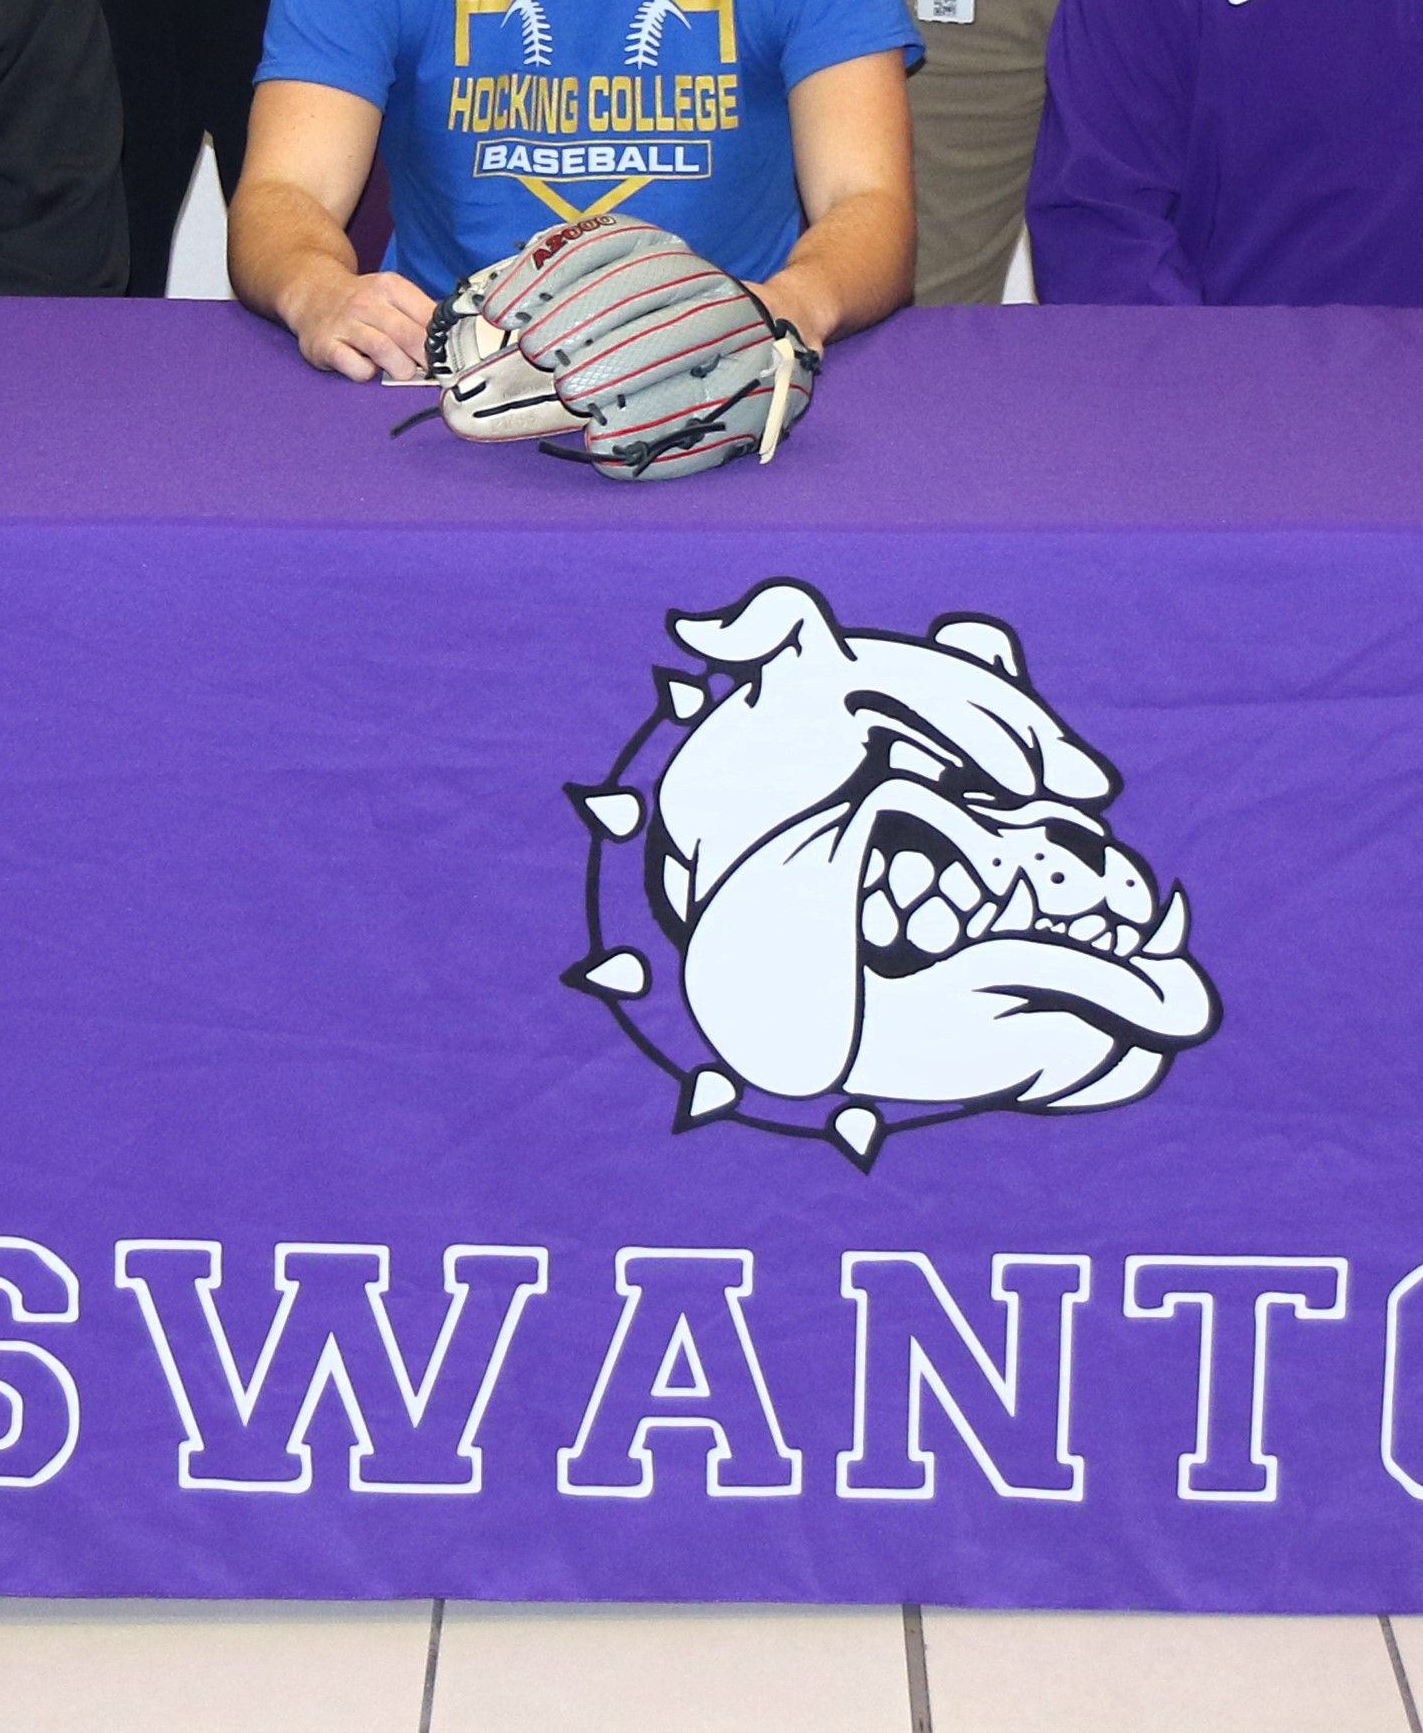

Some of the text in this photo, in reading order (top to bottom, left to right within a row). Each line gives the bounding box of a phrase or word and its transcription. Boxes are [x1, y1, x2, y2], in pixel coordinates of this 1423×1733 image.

[447, 74, 738, 134] HOCKING COLLEGE
[482, 145, 700, 175] BASEBALL
[533, 215, 617, 270] A2000
